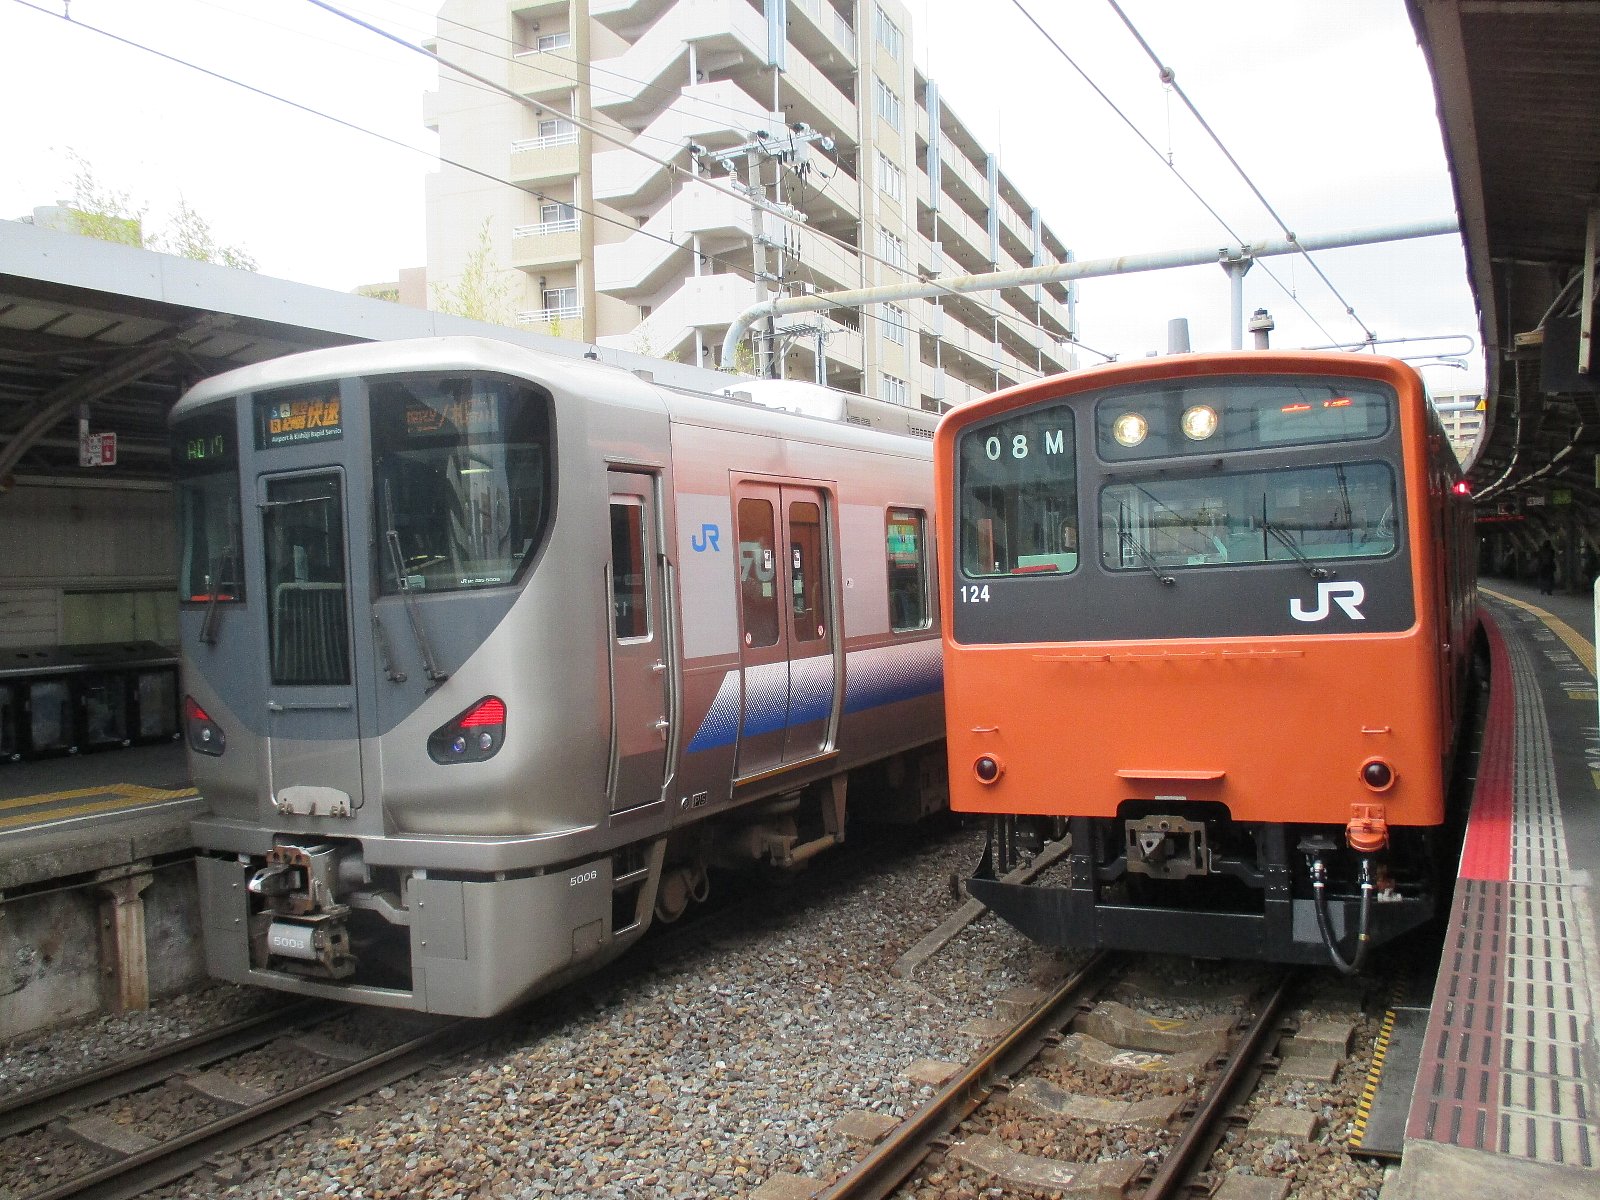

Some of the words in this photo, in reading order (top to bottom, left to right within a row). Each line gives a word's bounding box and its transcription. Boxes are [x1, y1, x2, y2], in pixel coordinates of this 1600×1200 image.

[1045, 429, 1064, 455] M
[691, 523, 720, 552] JR
[960, 584, 991, 603] 124
[1290, 581, 1366, 622] JR
[570, 870, 597, 886] 5006
